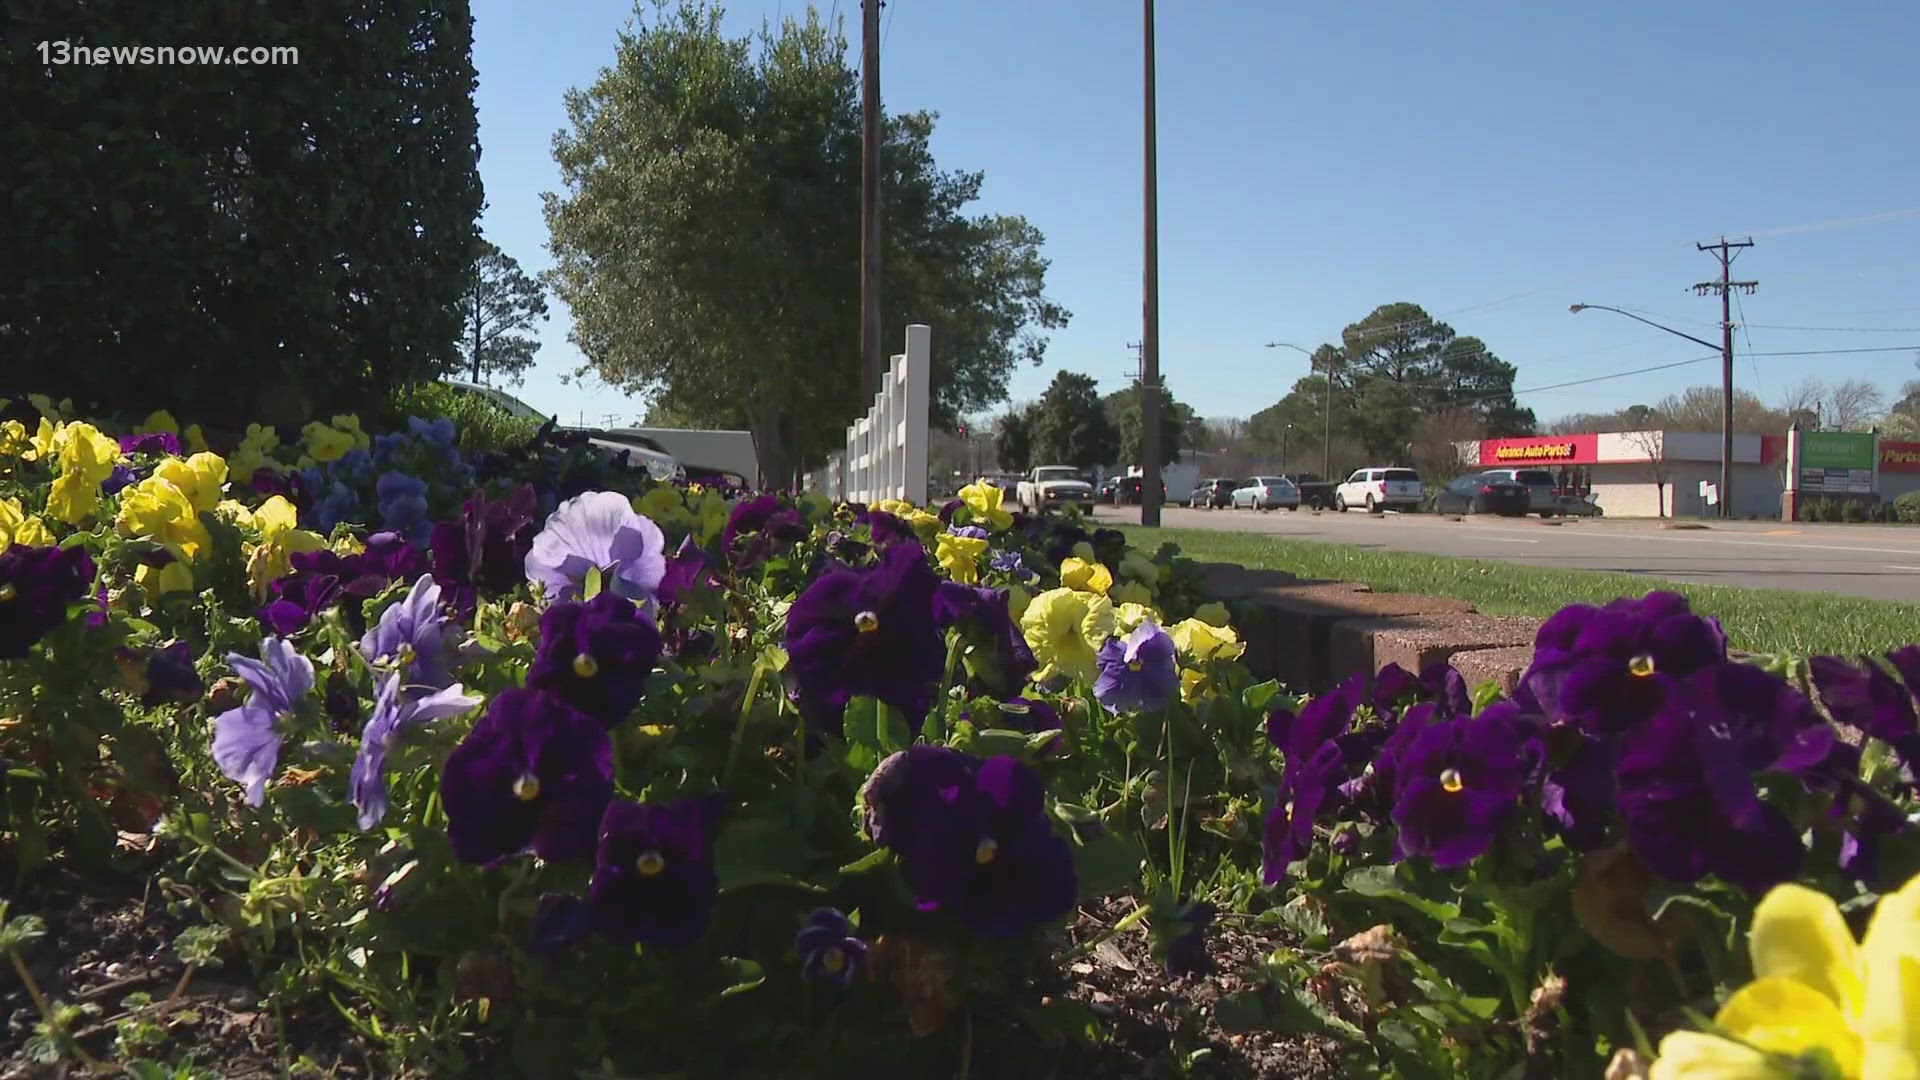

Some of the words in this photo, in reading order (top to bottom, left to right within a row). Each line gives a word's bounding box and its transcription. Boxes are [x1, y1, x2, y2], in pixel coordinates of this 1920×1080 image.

[1496, 446, 1524, 459] Advance
[1524, 445, 1543, 458] Auto
[1543, 444, 1565, 457] Parts
[1805, 439, 1855, 453] Walmart
